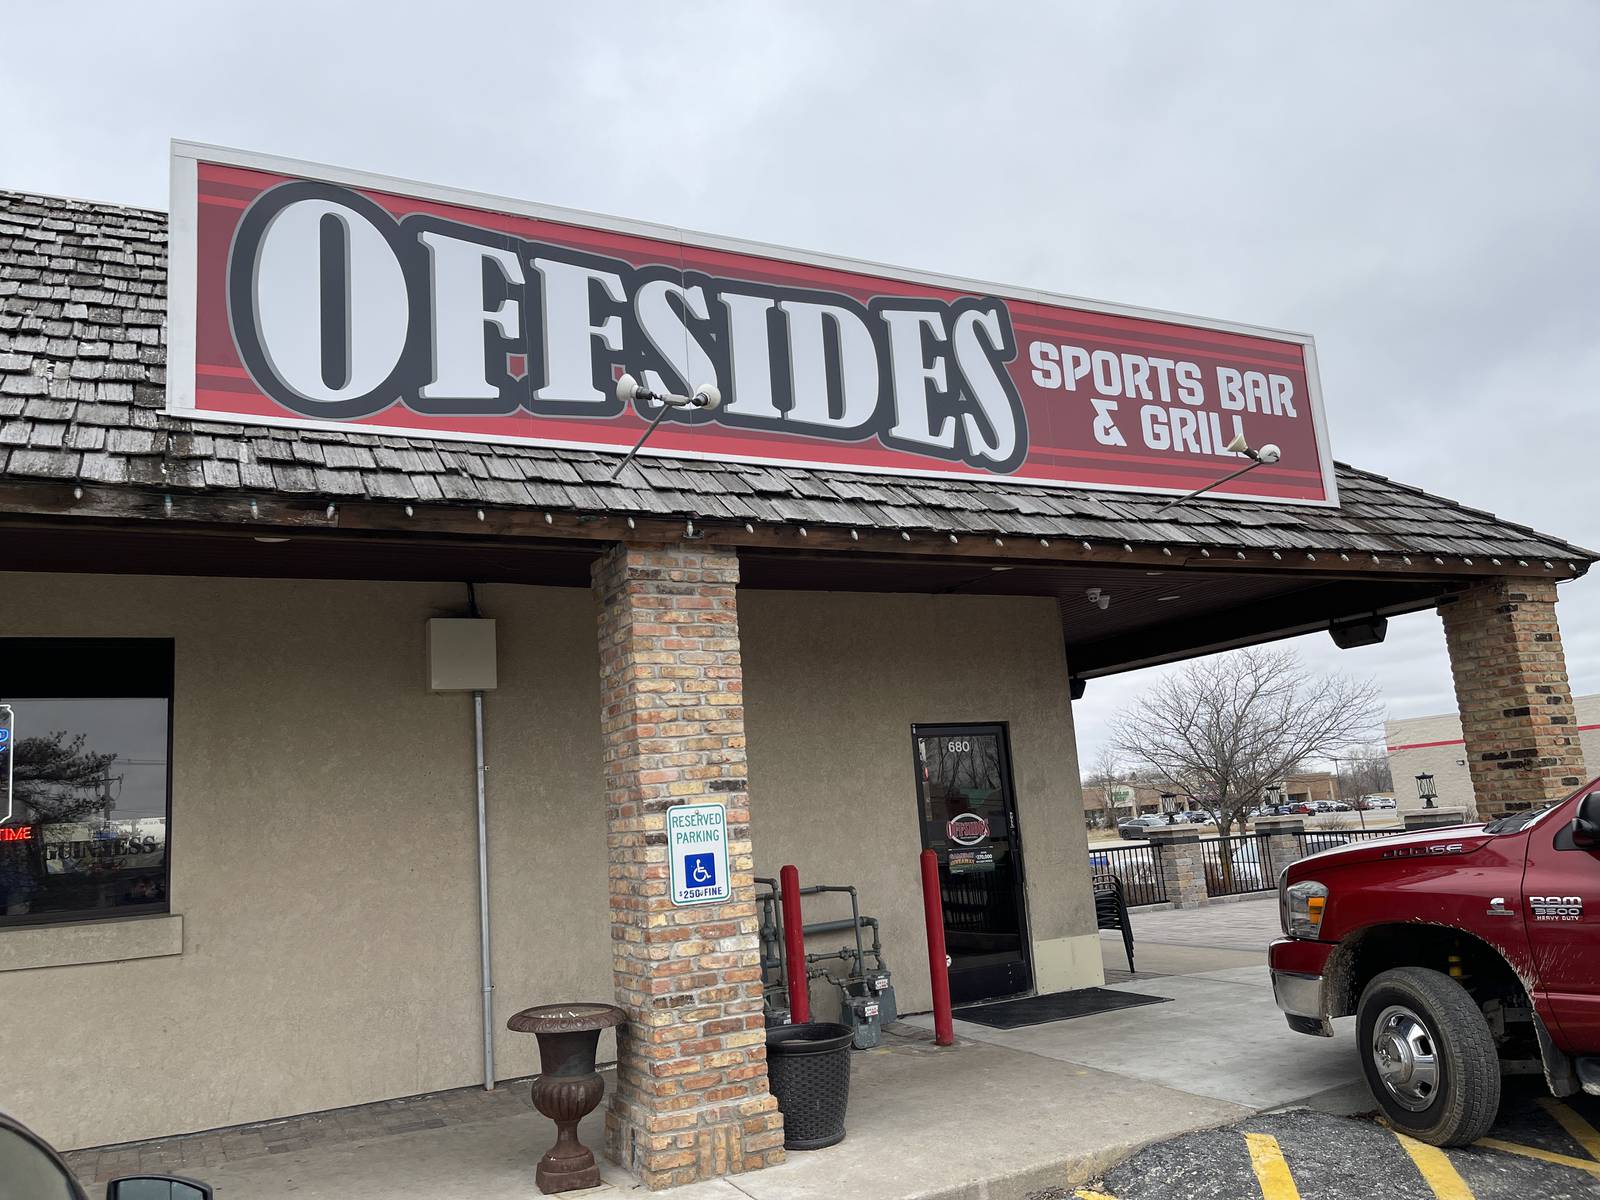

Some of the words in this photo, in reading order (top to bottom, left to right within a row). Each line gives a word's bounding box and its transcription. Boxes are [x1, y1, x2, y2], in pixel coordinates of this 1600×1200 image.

[251, 198, 1019, 463] OFFSIDES
[1028, 341, 1205, 406] SPORTS
[1215, 366, 1298, 418] BAR
[1090, 398, 1128, 447] &
[1140, 404, 1253, 459] GRILL
[948, 741, 970, 753] 680
[671, 812, 722, 829] RESERVED
[676, 829, 720, 845] PARKING
[679, 888, 701, 899] $250
[704, 886, 723, 897] FINE
[1529, 896, 1583, 907] RAM
[1534, 907, 1580, 915] 3500
